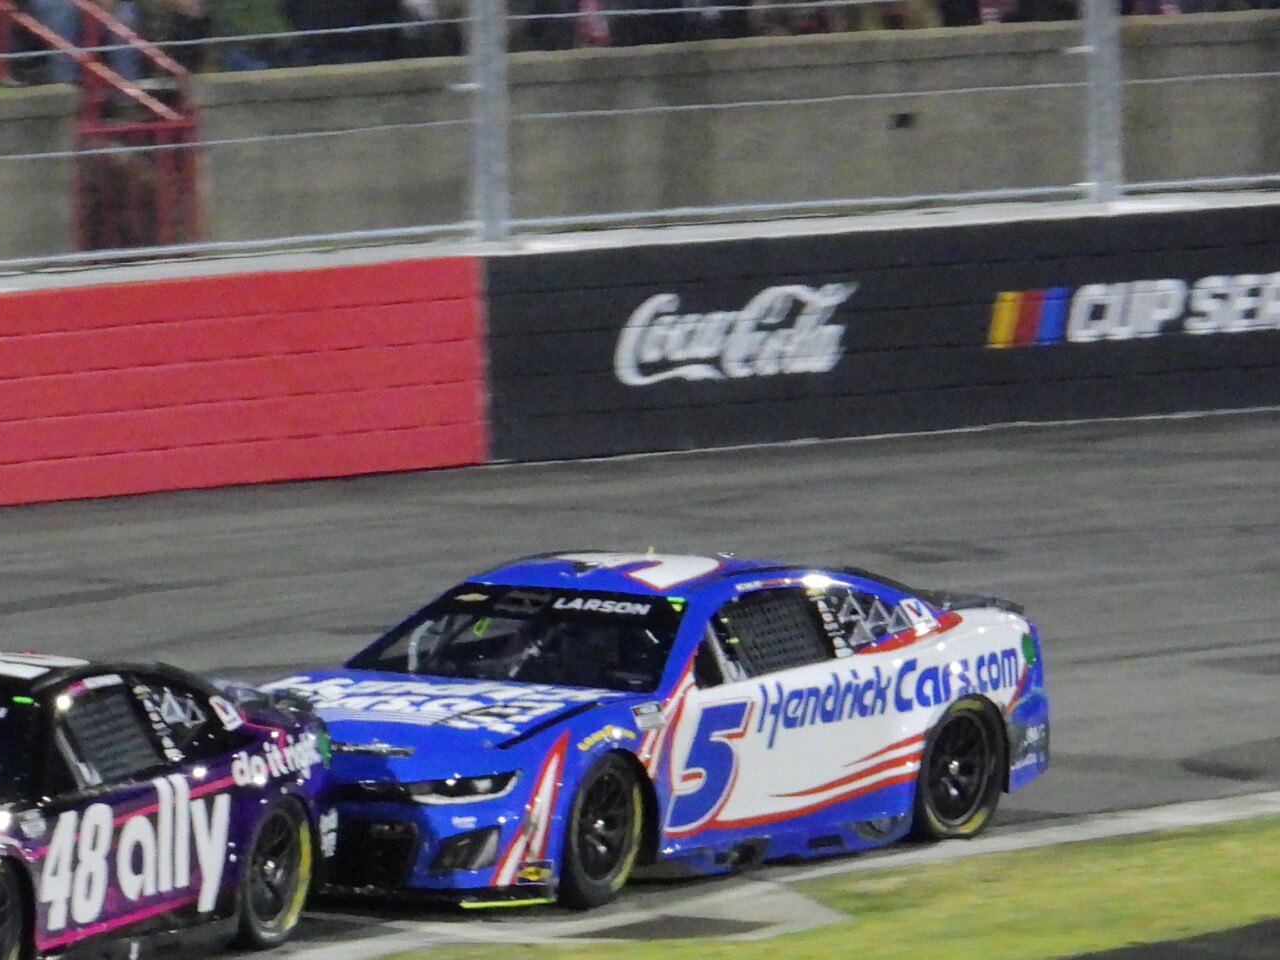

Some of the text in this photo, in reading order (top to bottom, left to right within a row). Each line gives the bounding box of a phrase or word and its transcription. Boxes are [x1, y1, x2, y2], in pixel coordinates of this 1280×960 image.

[614, 281, 861, 386] Coca-Cola
[1067, 279, 1189, 342] CUP
[552, 597, 652, 616] LARSON
[665, 700, 754, 838] 5
[39, 803, 114, 931] 48
[116, 772, 232, 913] ally
